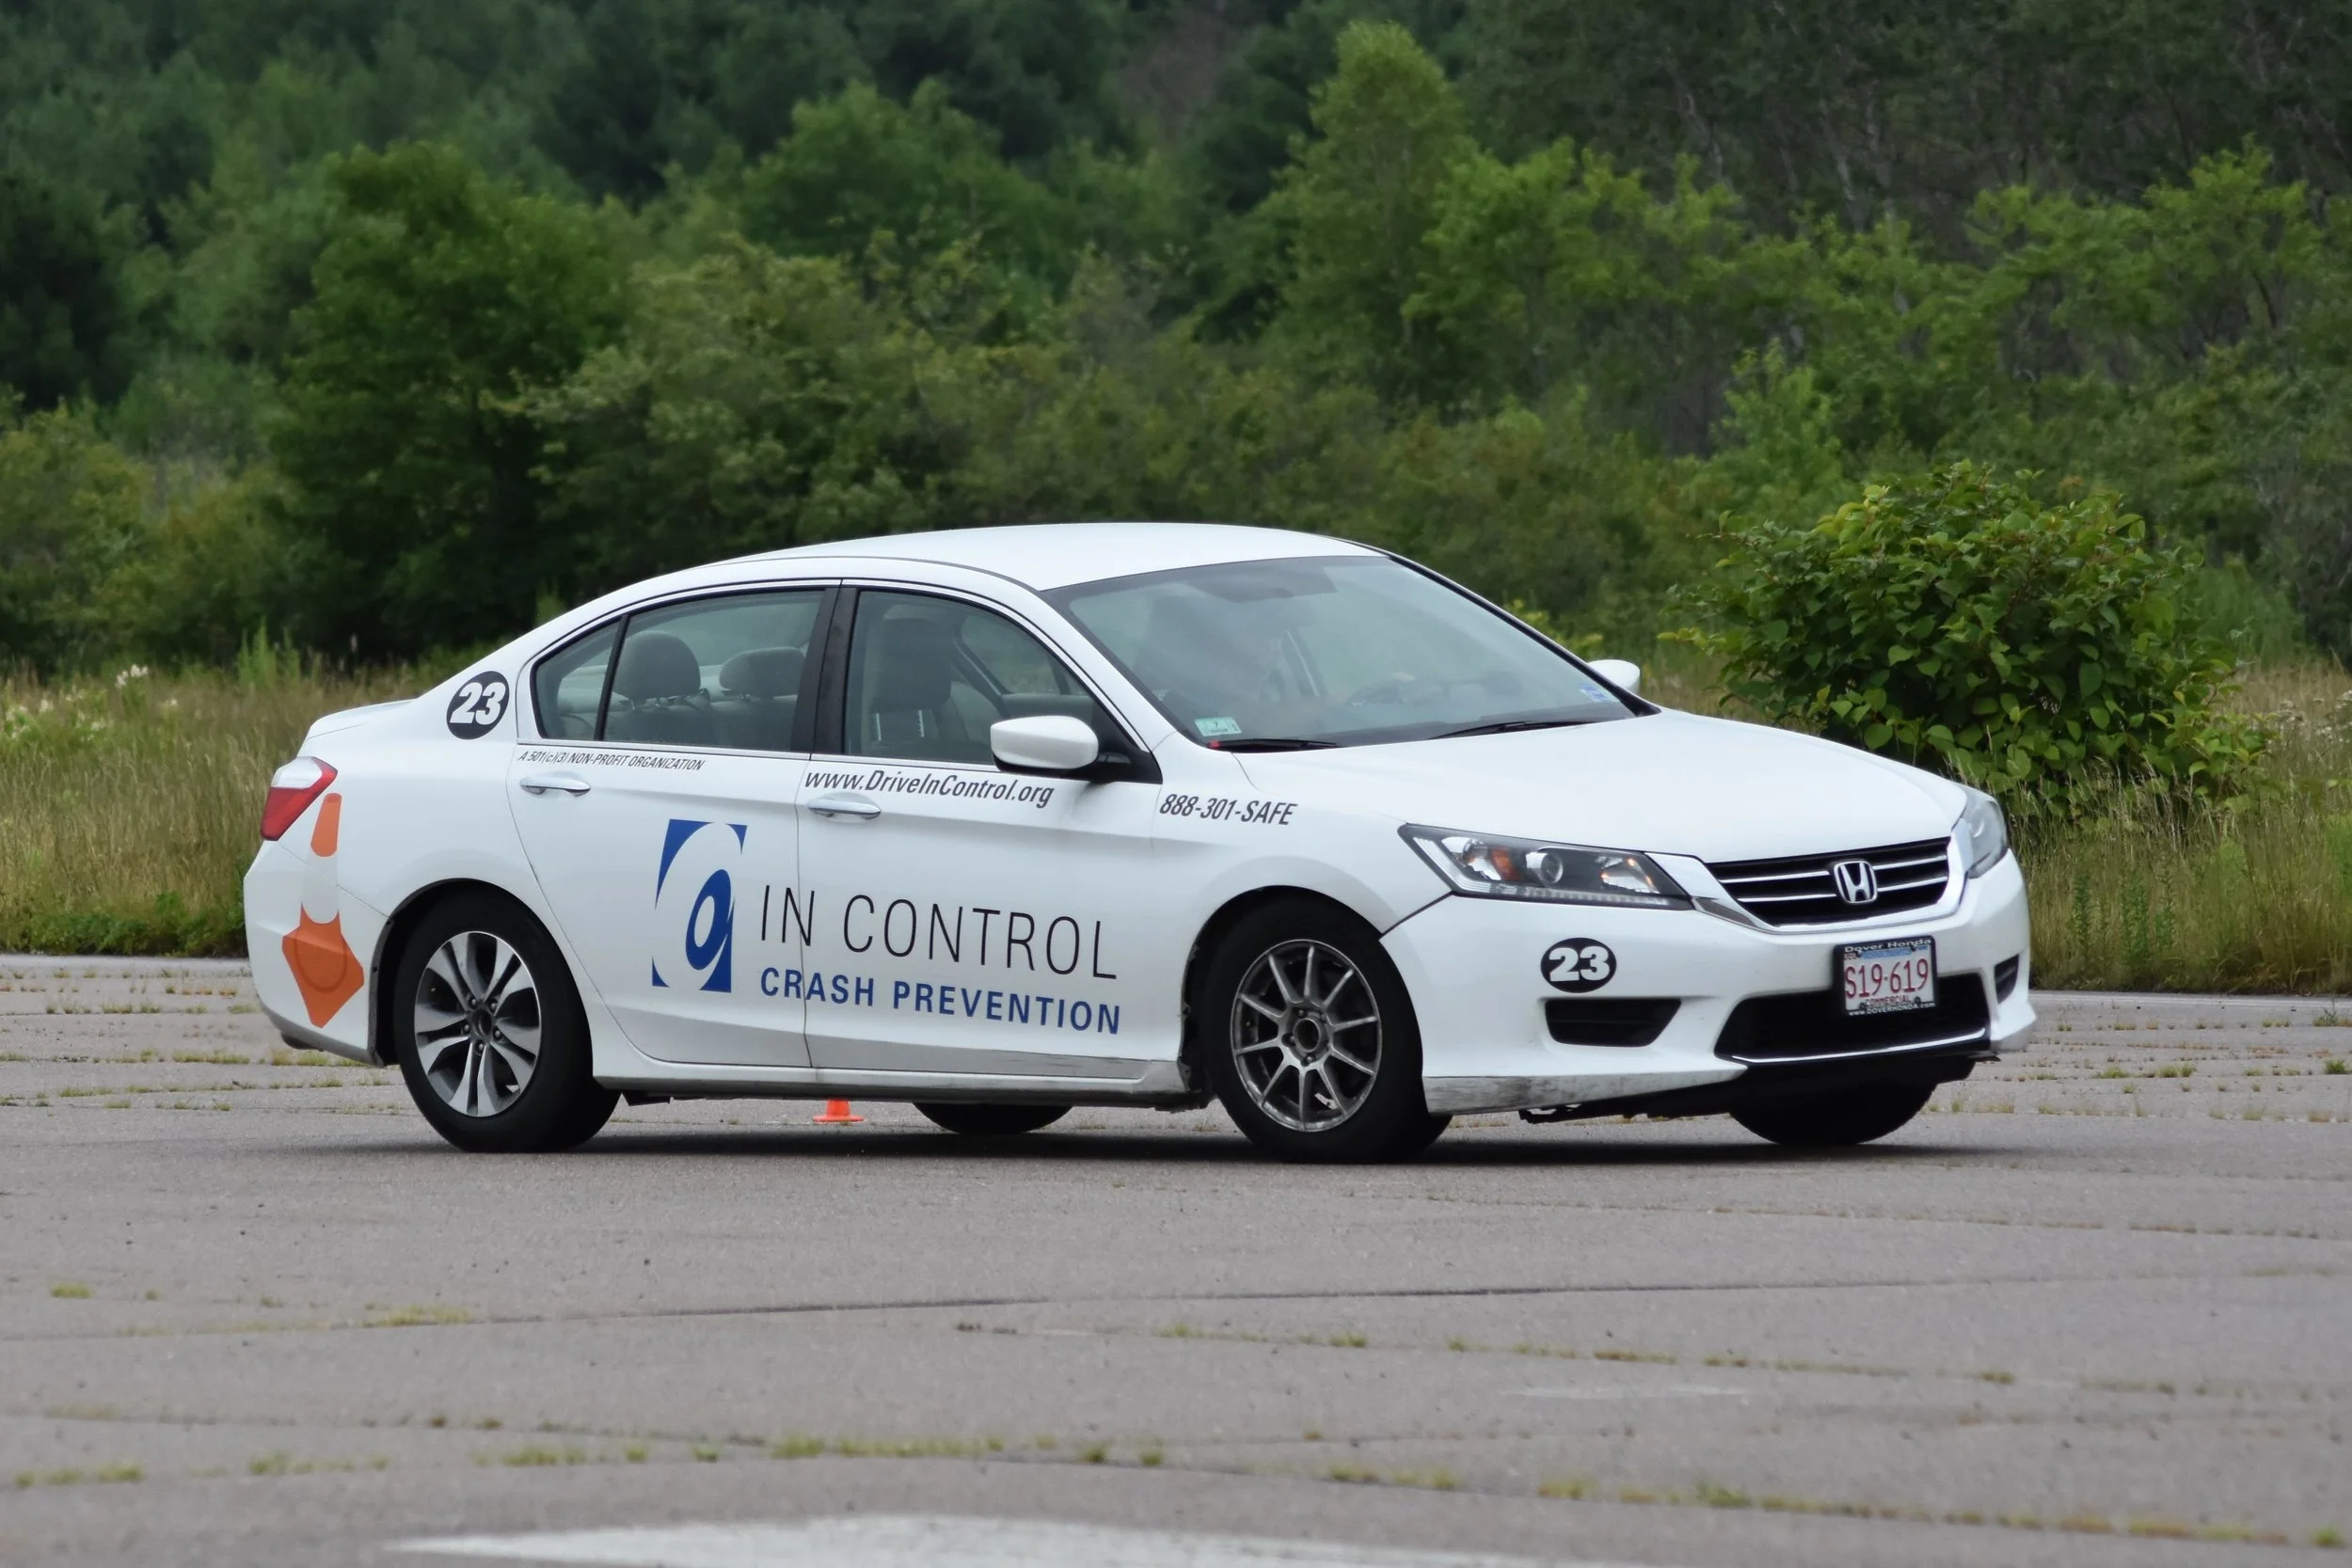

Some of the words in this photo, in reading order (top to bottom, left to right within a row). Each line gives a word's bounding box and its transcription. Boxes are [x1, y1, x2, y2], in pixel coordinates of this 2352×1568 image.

[450, 682, 506, 725] 23
[518, 751, 529, 761] A
[567, 752, 630, 767] NON-PROFIT
[628, 755, 706, 771] ORGANIZATION
[804, 769, 1055, 809] www.DriveInControl.org
[1159, 793, 1298, 826] 888-301-SAFE
[760, 884, 815, 946] IN
[844, 895, 1118, 980] CONTROL
[1844, 943, 1883, 953] Dover
[1887, 938, 1931, 948] Honda
[1549, 945, 1611, 982] 23
[760, 966, 874, 1007] CRASH
[893, 980, 1120, 1035] PREVENTION
[1849, 1001, 1936, 1016] www.DOVERHONDA.com
